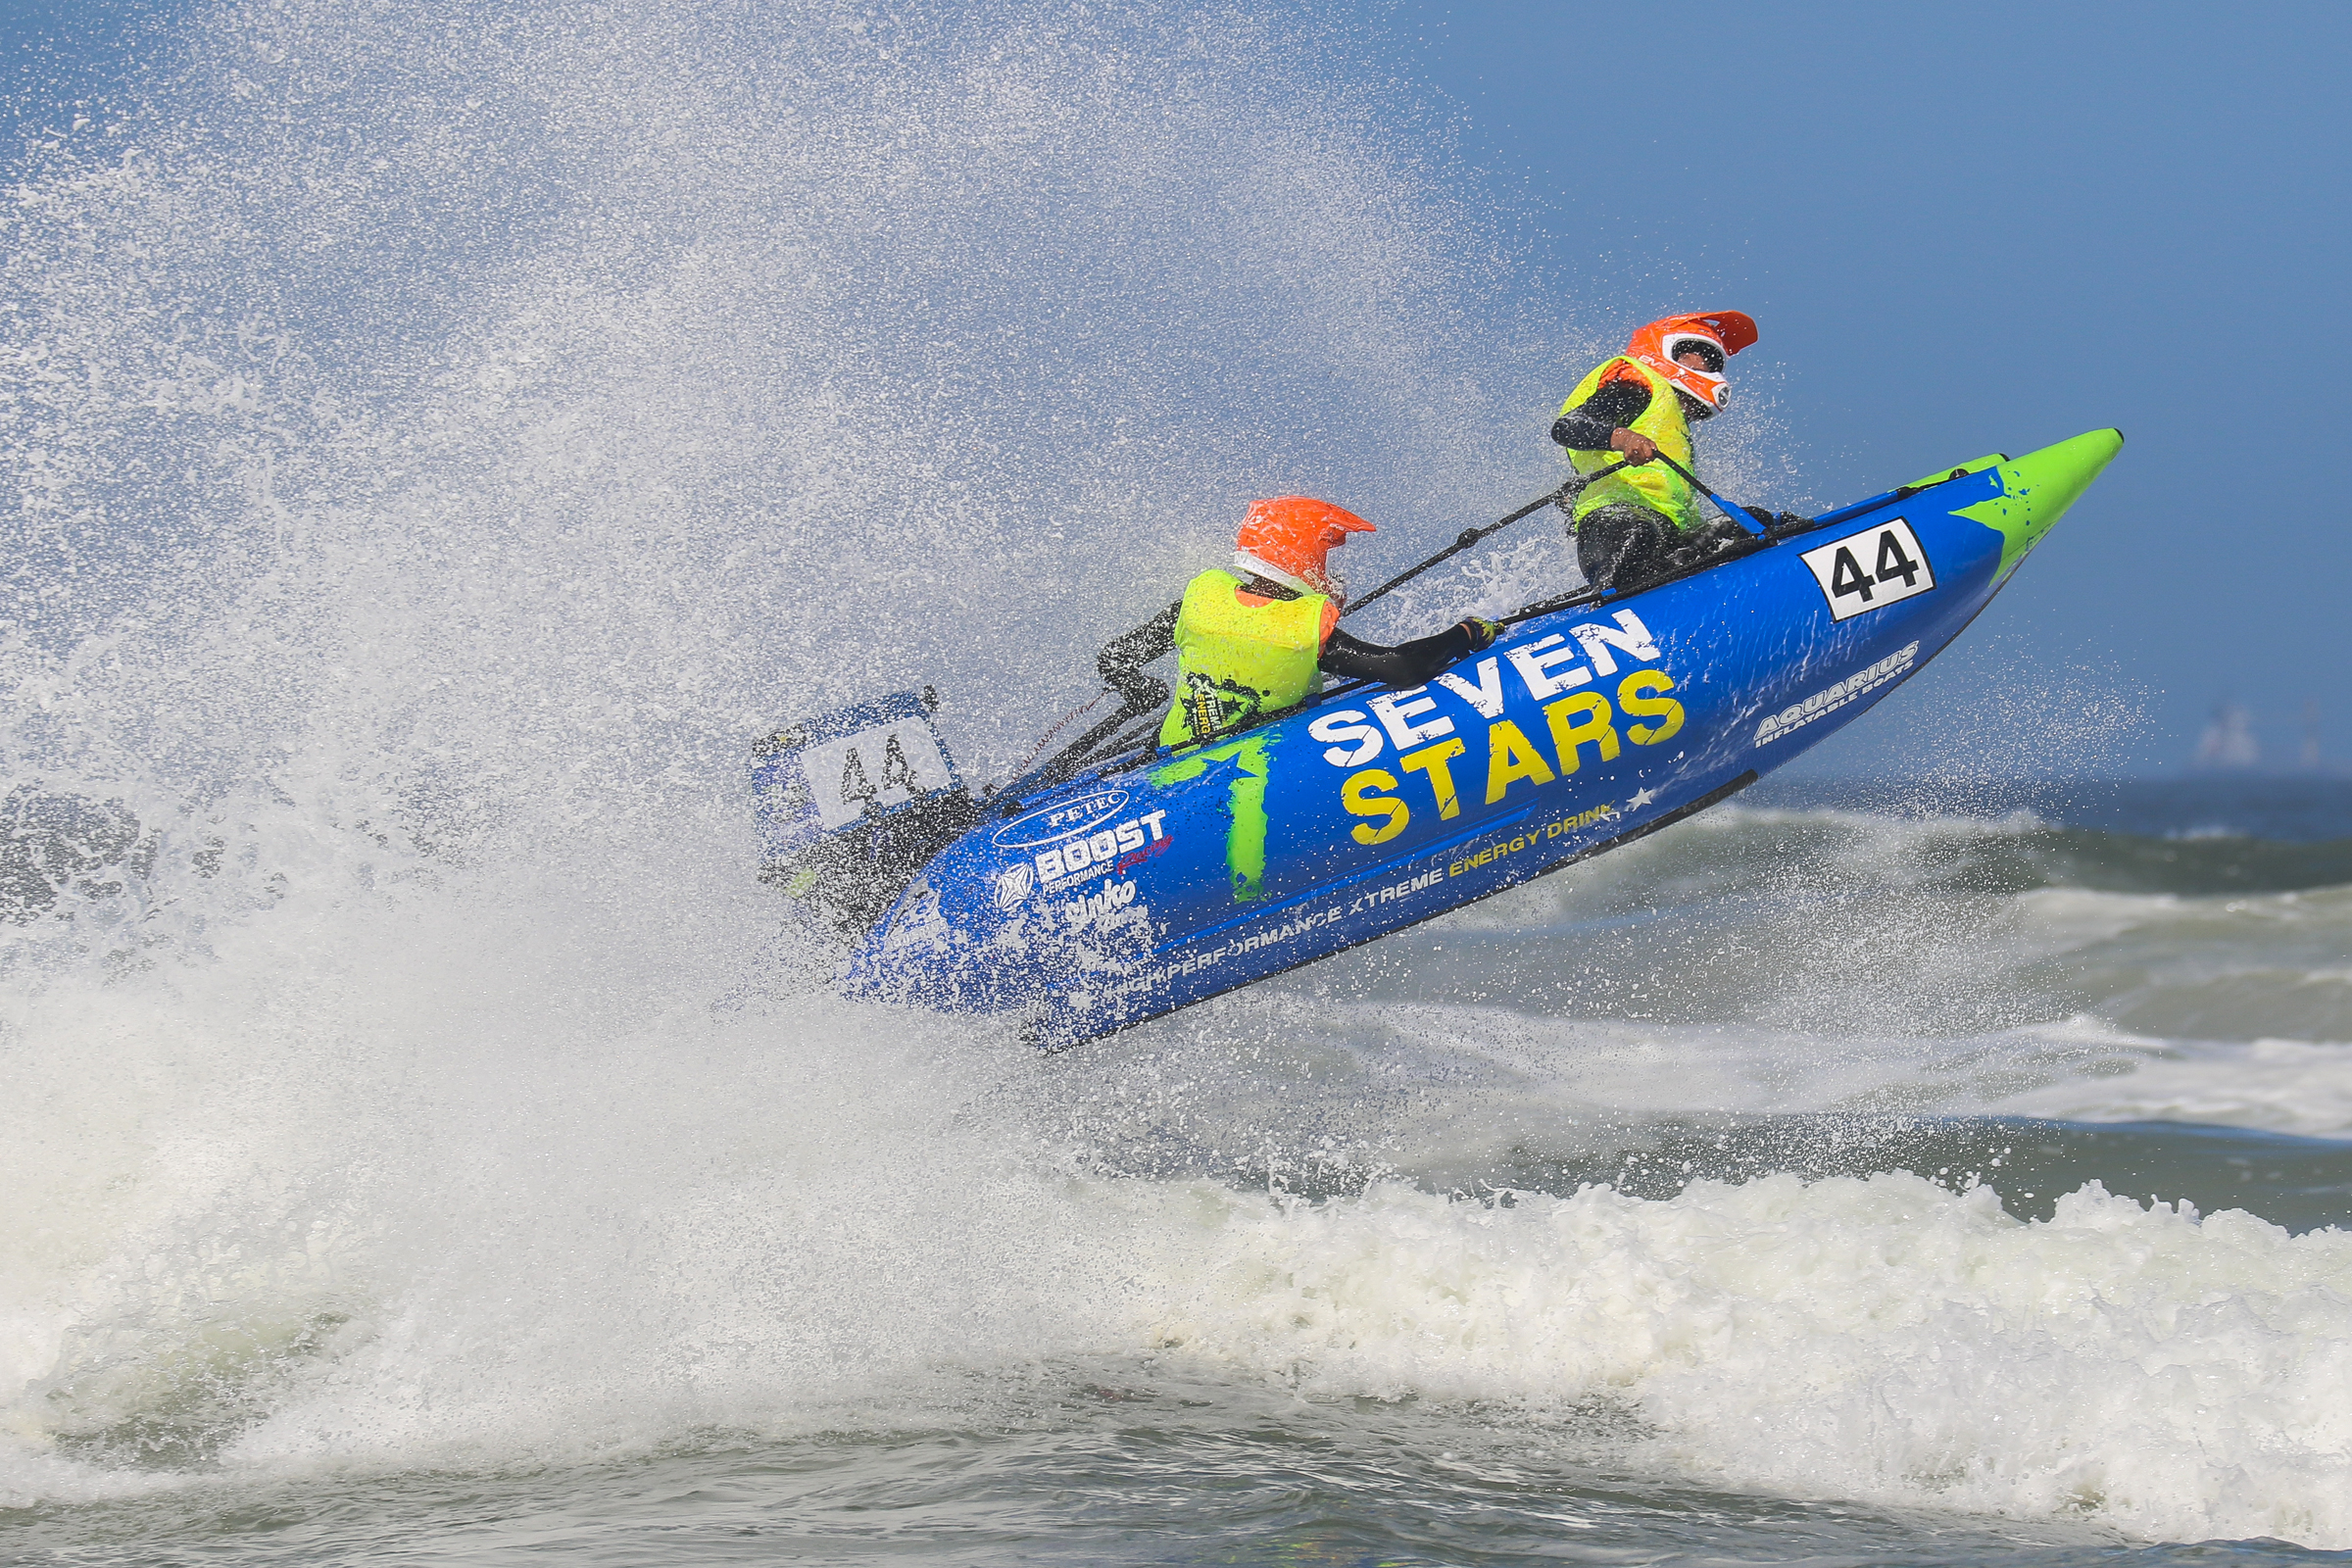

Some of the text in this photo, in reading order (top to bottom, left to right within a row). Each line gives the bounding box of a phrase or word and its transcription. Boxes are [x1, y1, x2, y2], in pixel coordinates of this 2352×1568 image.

[1831, 529, 1921, 603] 44
[1196, 693, 1210, 734] ENERG
[1307, 608, 1662, 768] SEVEN
[1752, 640, 1920, 741] AQUARIUS
[1755, 660, 1914, 749] INFLATABLE BOATS
[840, 734, 918, 807] 44
[1341, 669, 1686, 846] STARS
[1034, 809, 1167, 884] BOOST
[1048, 792, 1121, 828] PETEC
[1042, 860, 1114, 896] PERFORMANCE
[1166, 906, 1344, 981] PERFORMANCE
[1348, 868, 1444, 916] XTREME
[1448, 829, 1541, 878] ENERGY
